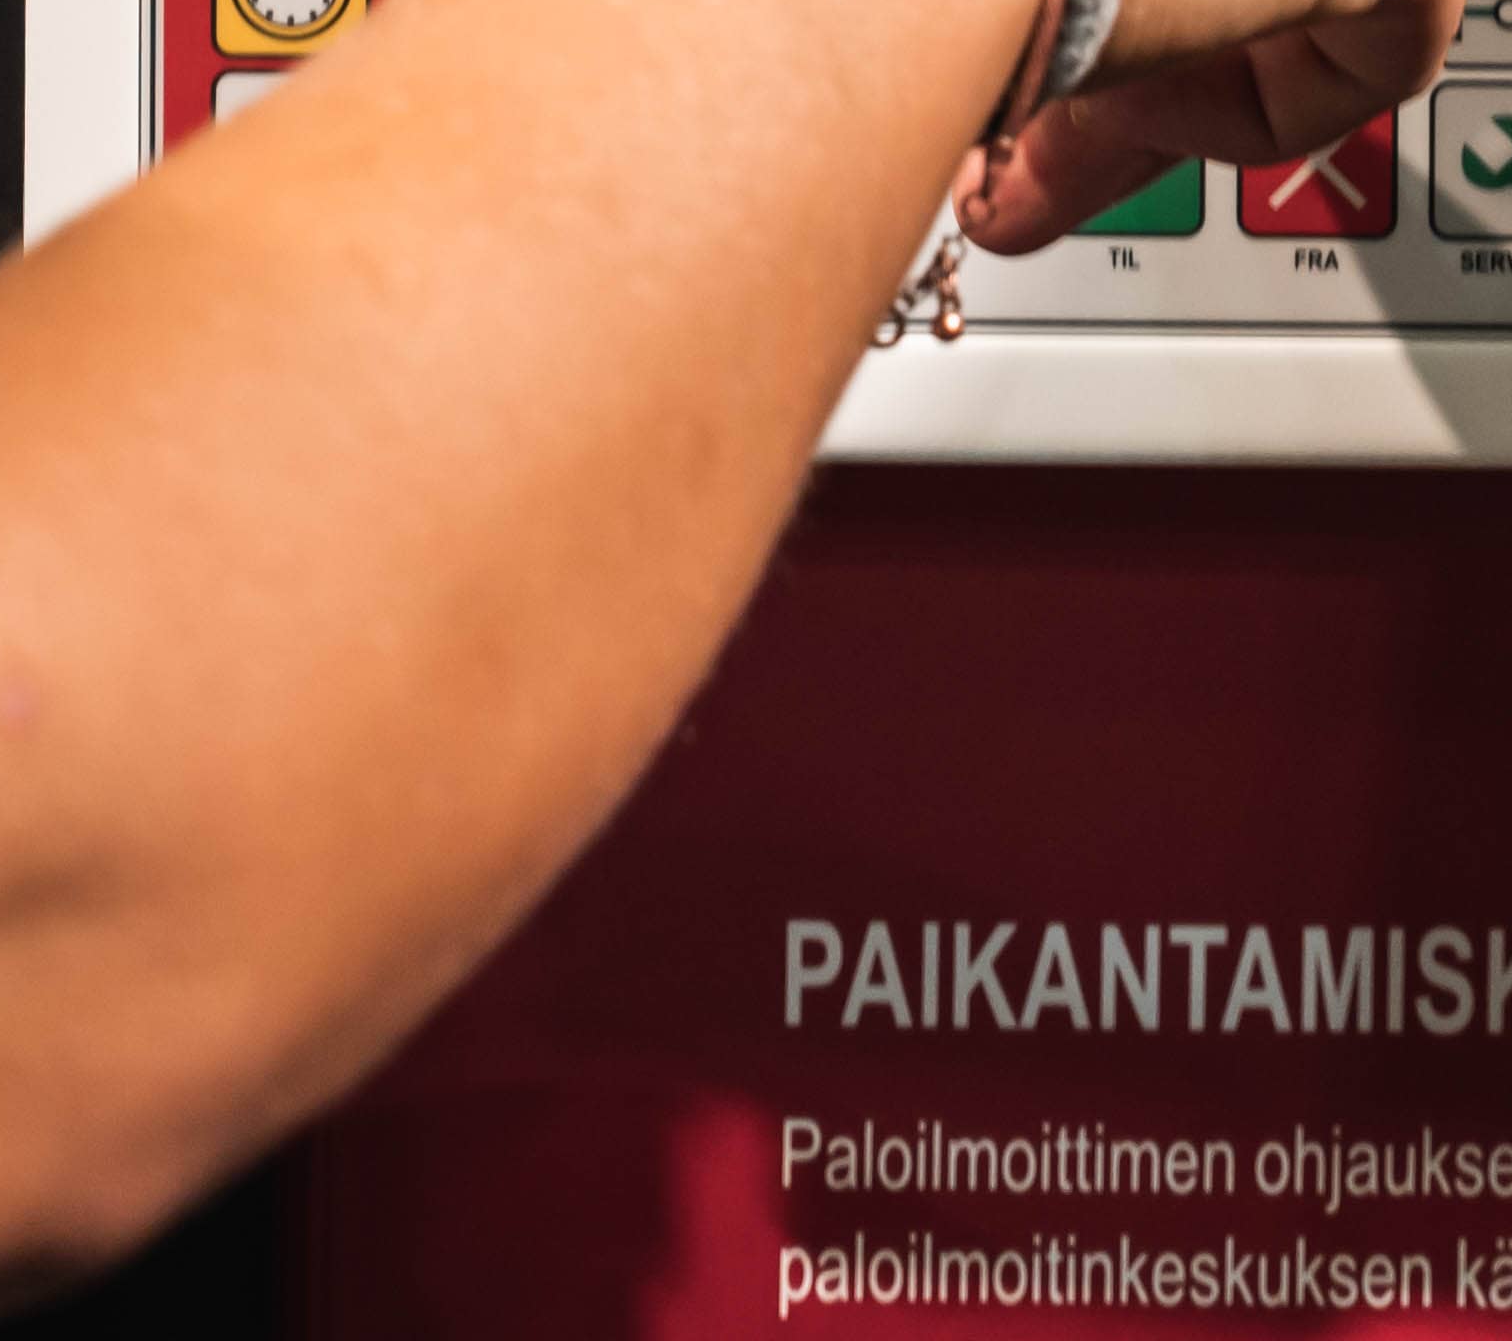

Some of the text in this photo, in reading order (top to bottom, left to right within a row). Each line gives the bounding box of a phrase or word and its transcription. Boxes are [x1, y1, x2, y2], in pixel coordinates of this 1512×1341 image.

[1109, 246, 1140, 270] TIL
[1293, 248, 1339, 272] FRA
[781, 1116, 1236, 1196] Paloilmoittimen
[777, 1232, 1433, 1323] paloilmoitinkeskuksen
